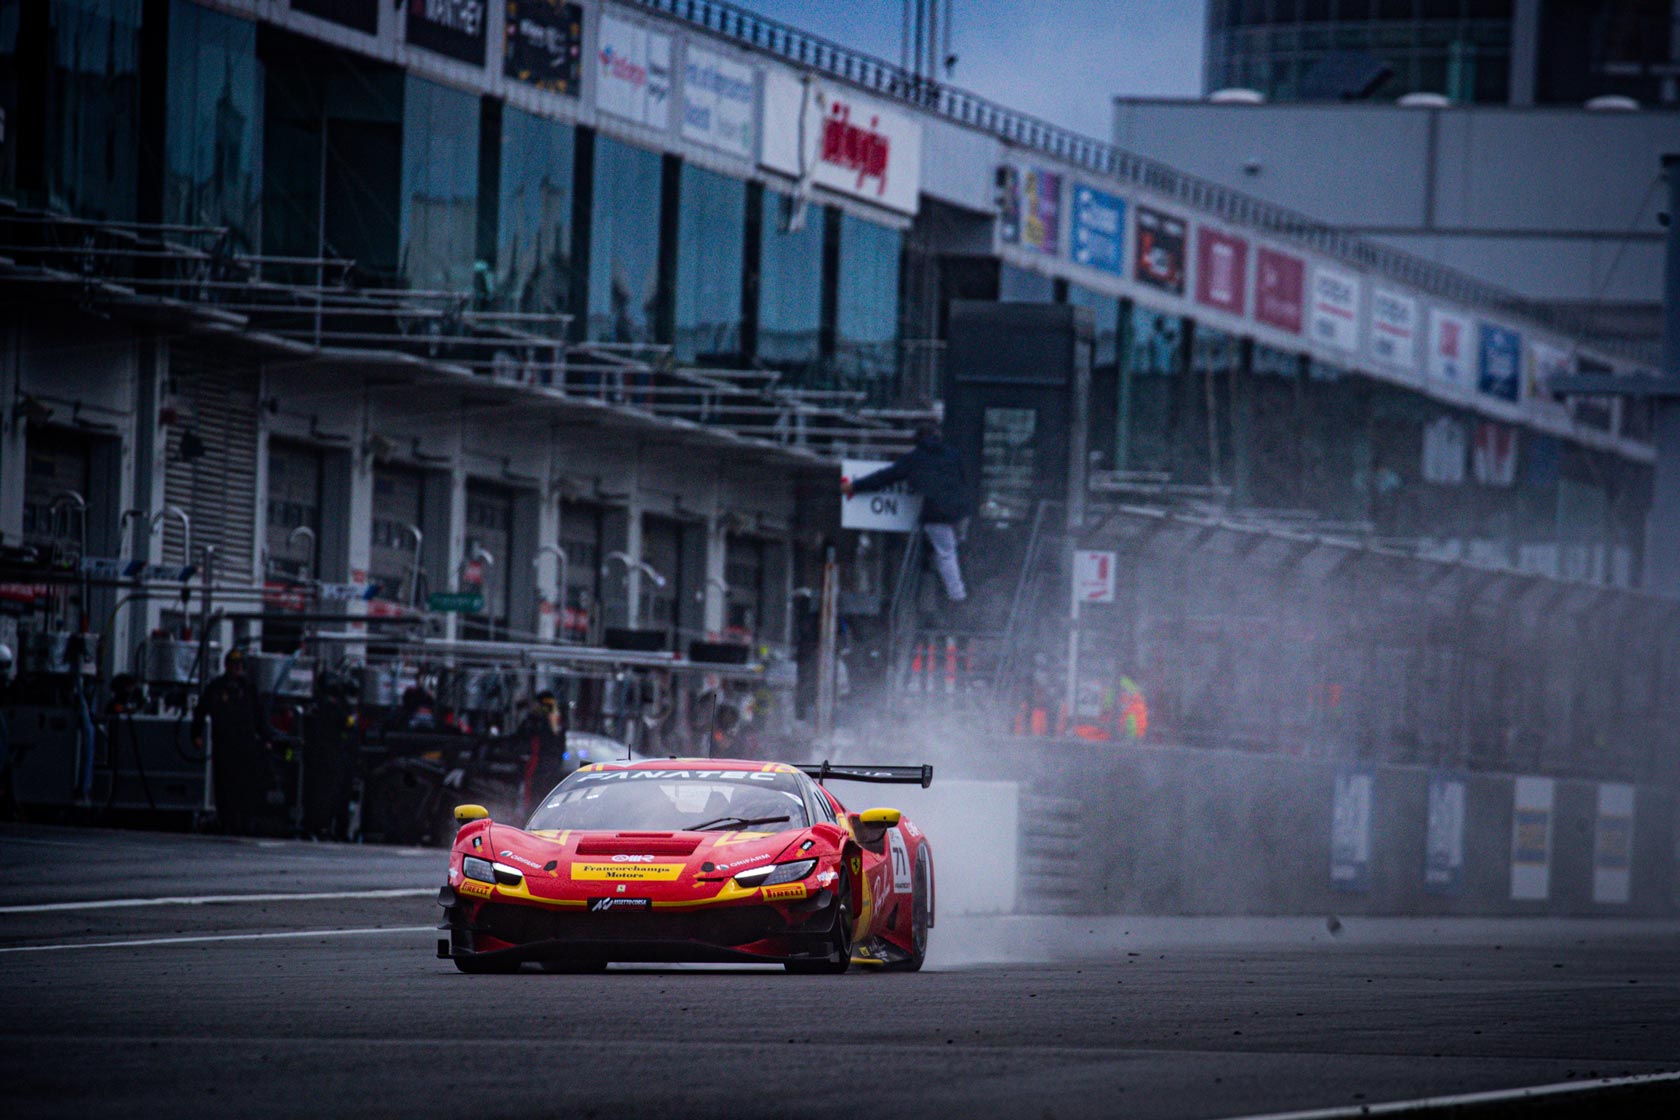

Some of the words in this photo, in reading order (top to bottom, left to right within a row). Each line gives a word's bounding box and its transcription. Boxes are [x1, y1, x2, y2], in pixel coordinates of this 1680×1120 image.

[871, 496, 897, 515] ON
[577, 771, 777, 782] FANATEC
[729, 853, 771, 867] ORIFARM
[892, 847, 906, 876] 71
[583, 865, 670, 873] Francorchamps
[462, 881, 489, 896] PIRELLI
[766, 885, 804, 898] PIRELLI
